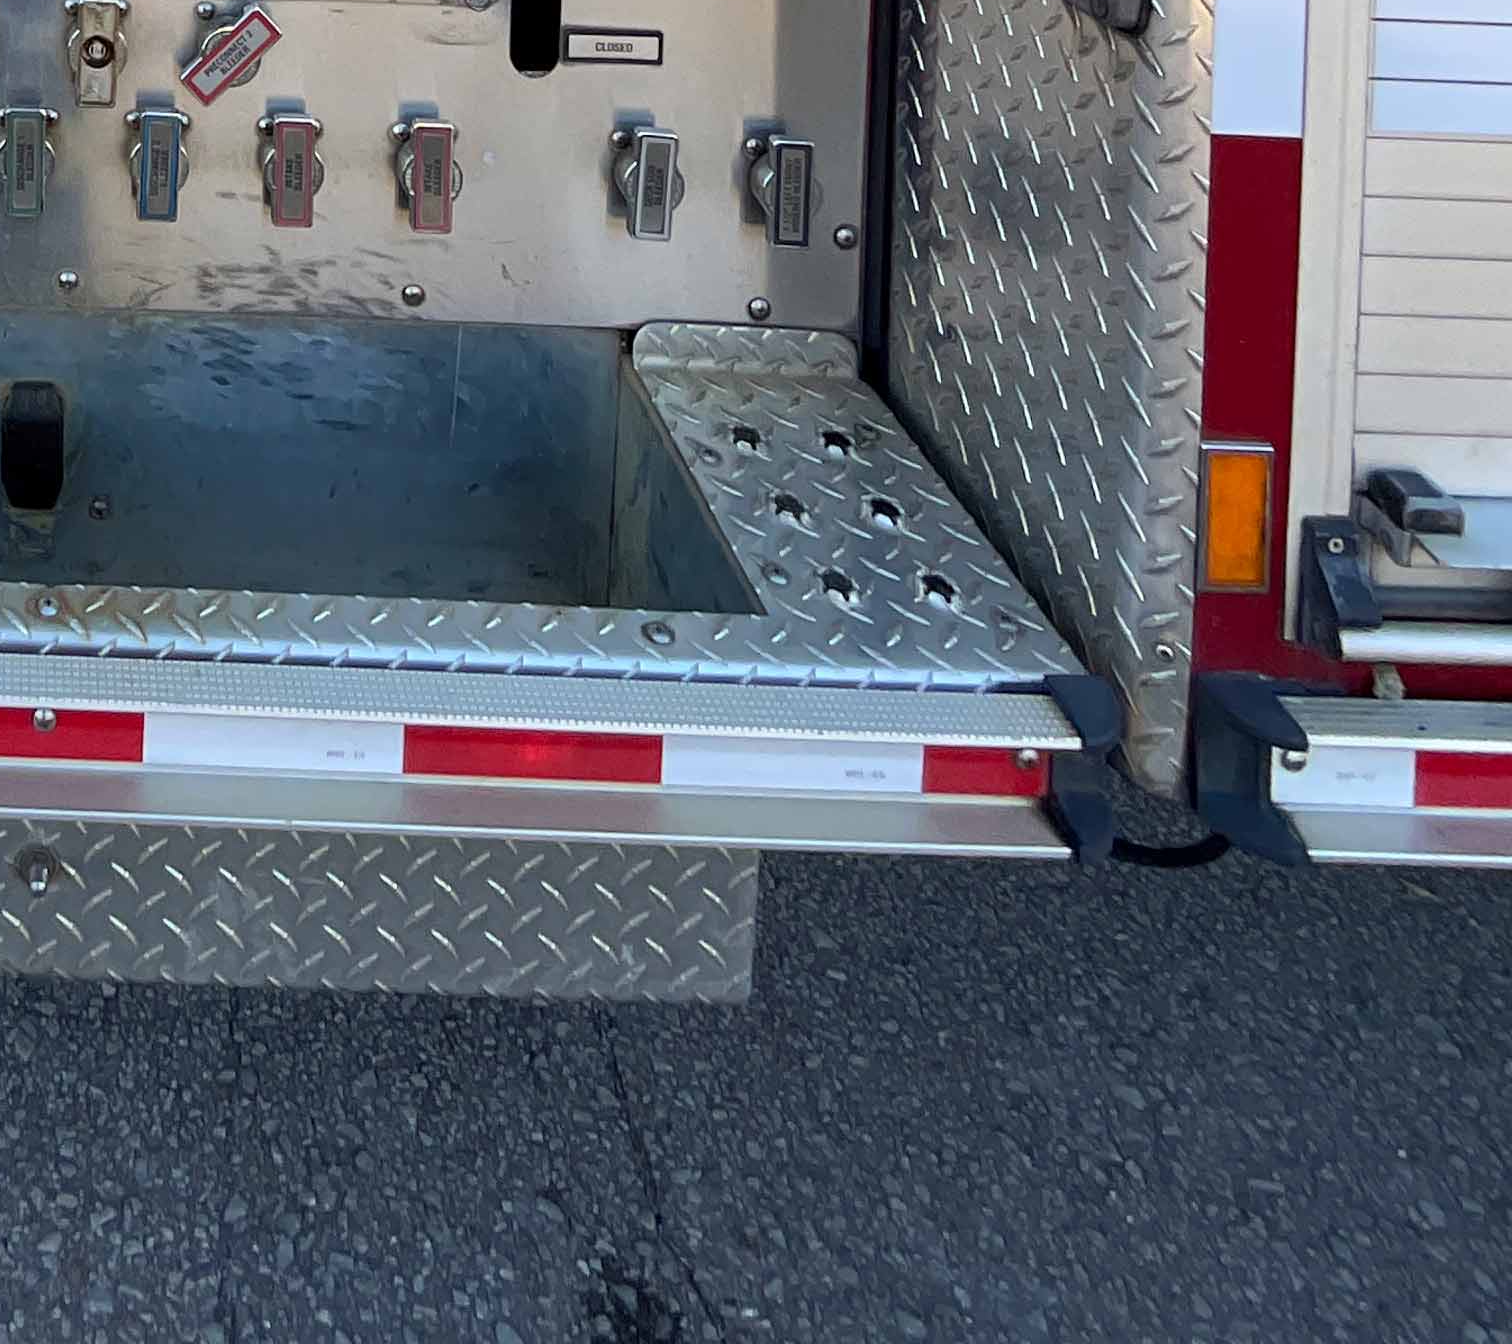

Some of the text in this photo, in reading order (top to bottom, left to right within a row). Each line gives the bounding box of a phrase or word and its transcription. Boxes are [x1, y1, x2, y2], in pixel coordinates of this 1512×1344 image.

[204, 36, 248, 77] PRECONNECT
[220, 46, 251, 75] BLEEDER
[595, 41, 633, 53] CLOSED
